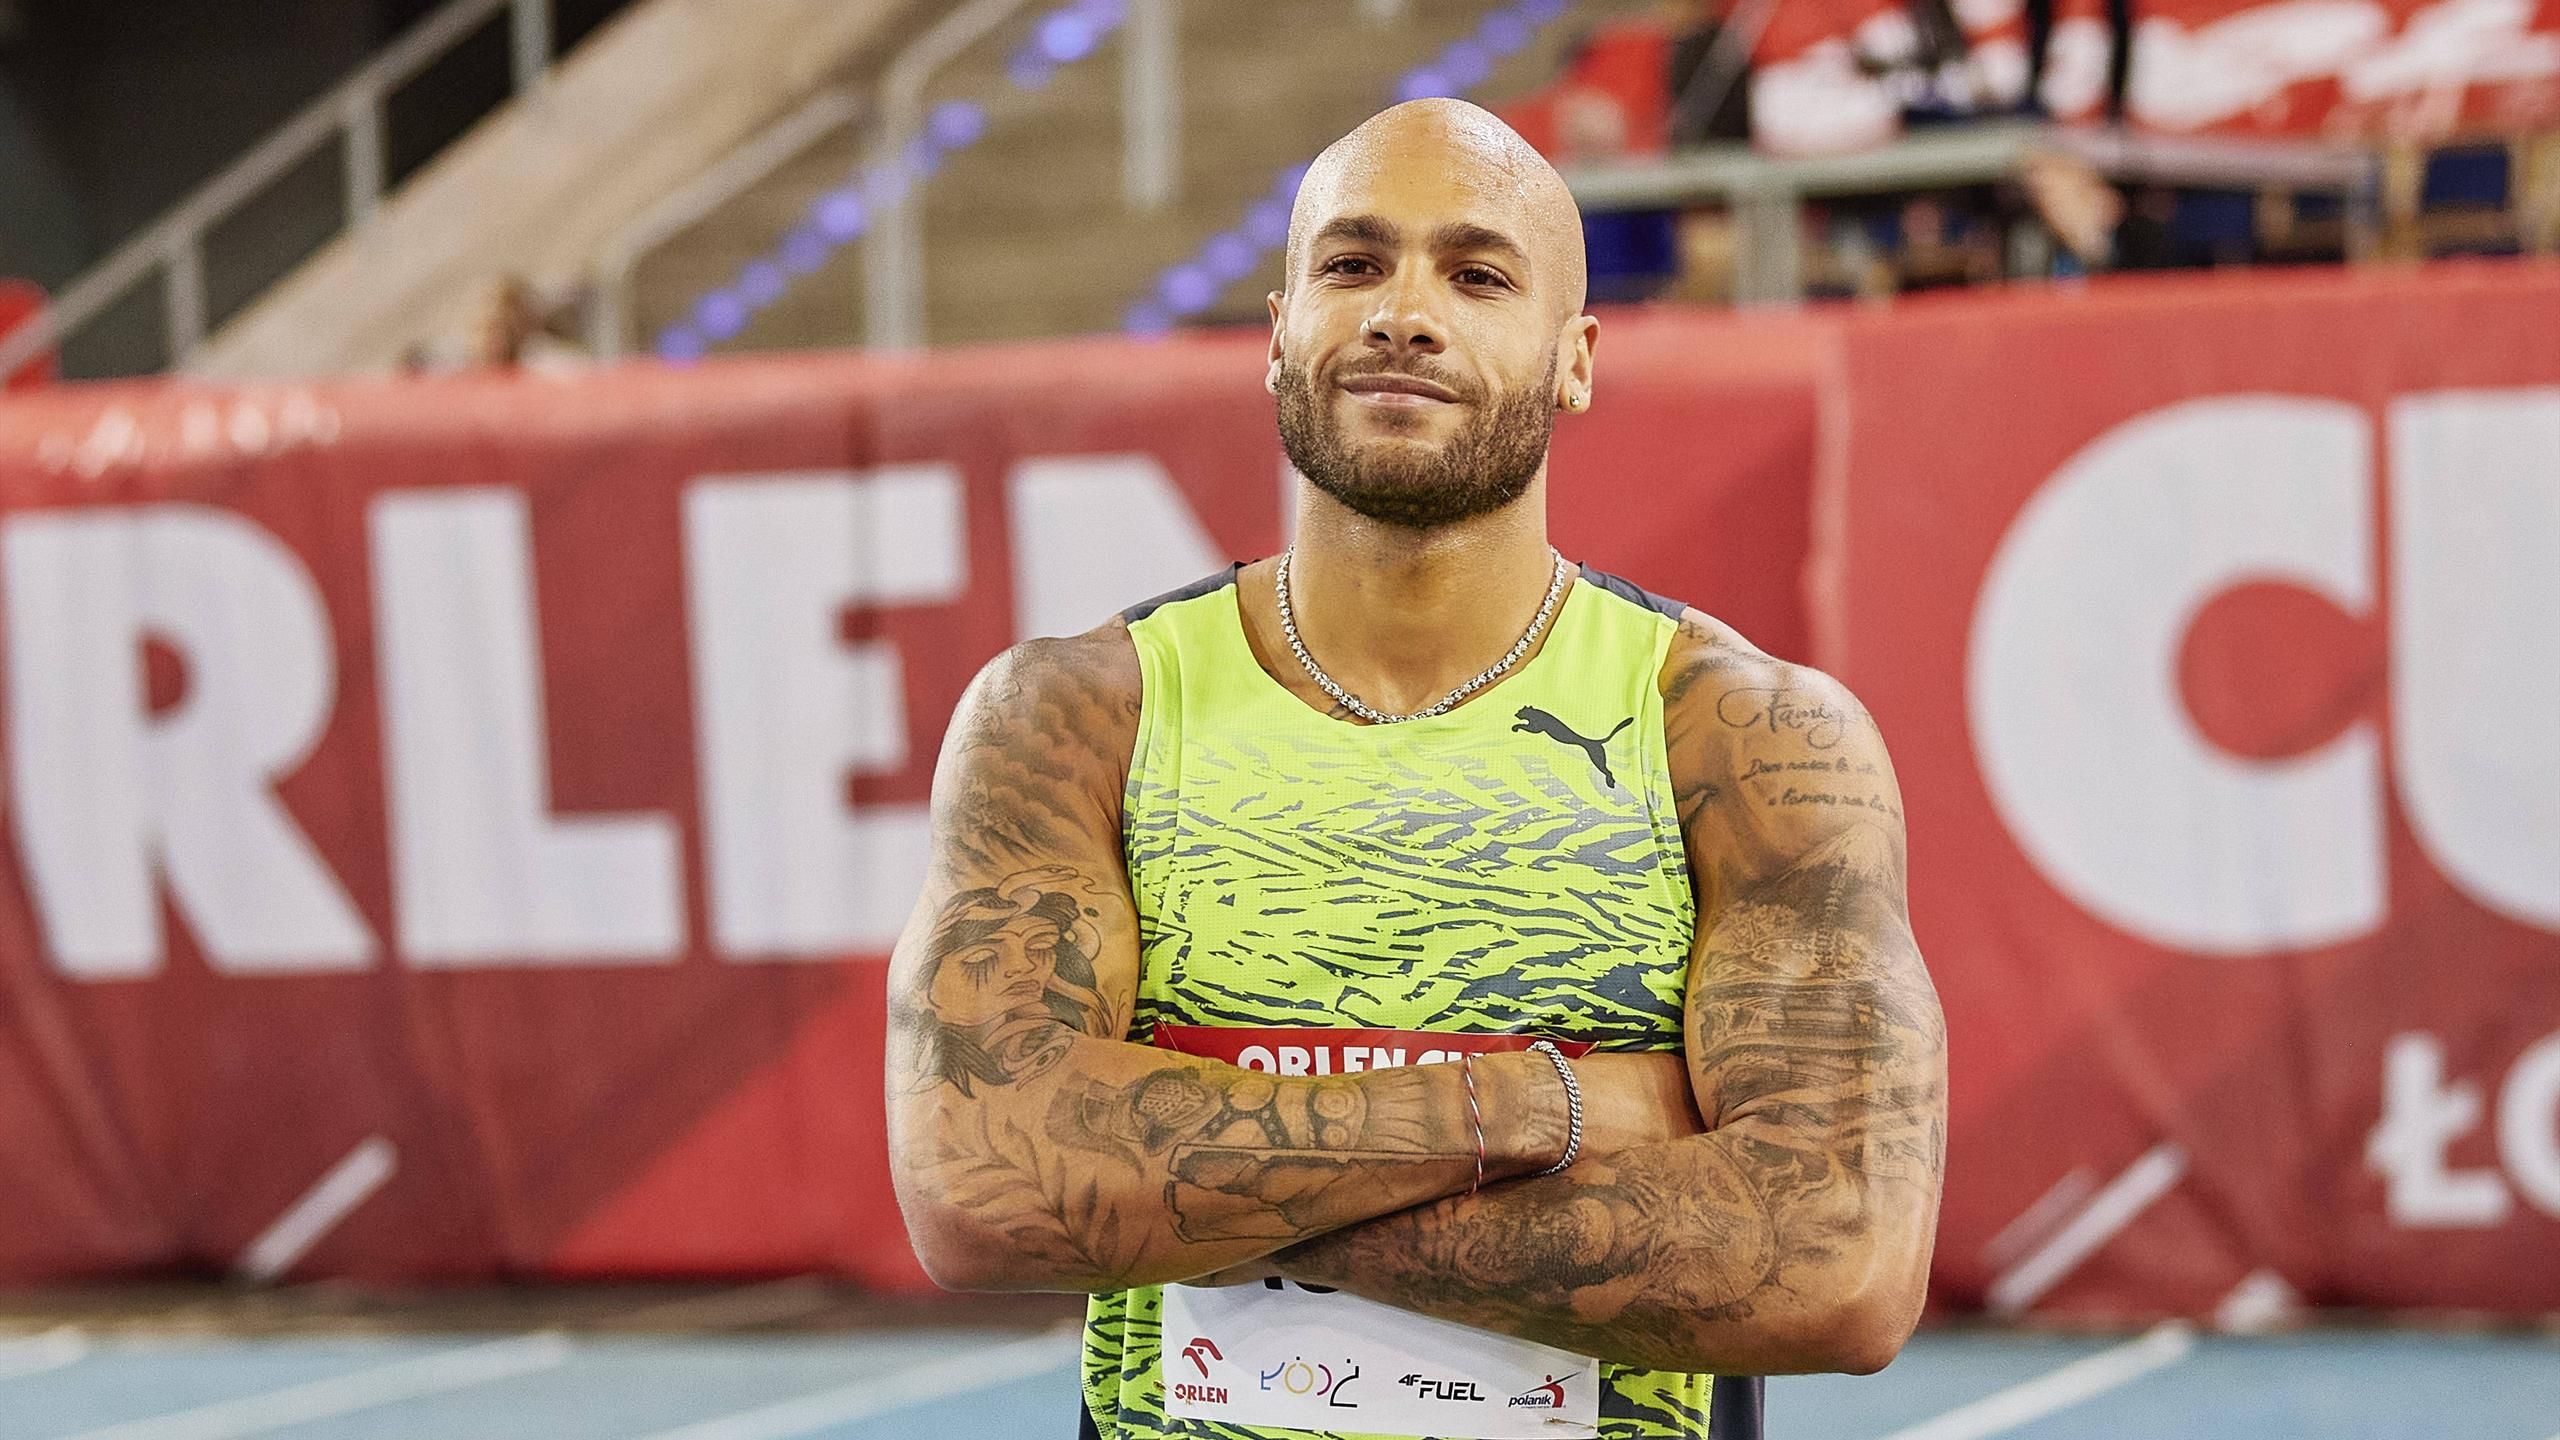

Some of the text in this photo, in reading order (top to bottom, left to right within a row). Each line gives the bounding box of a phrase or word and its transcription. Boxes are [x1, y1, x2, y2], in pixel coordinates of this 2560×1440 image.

[1174, 1383, 1228, 1404] ORLEN
[1419, 1380, 1485, 1401] FUEL
[1508, 1394, 1552, 1408] polanik
